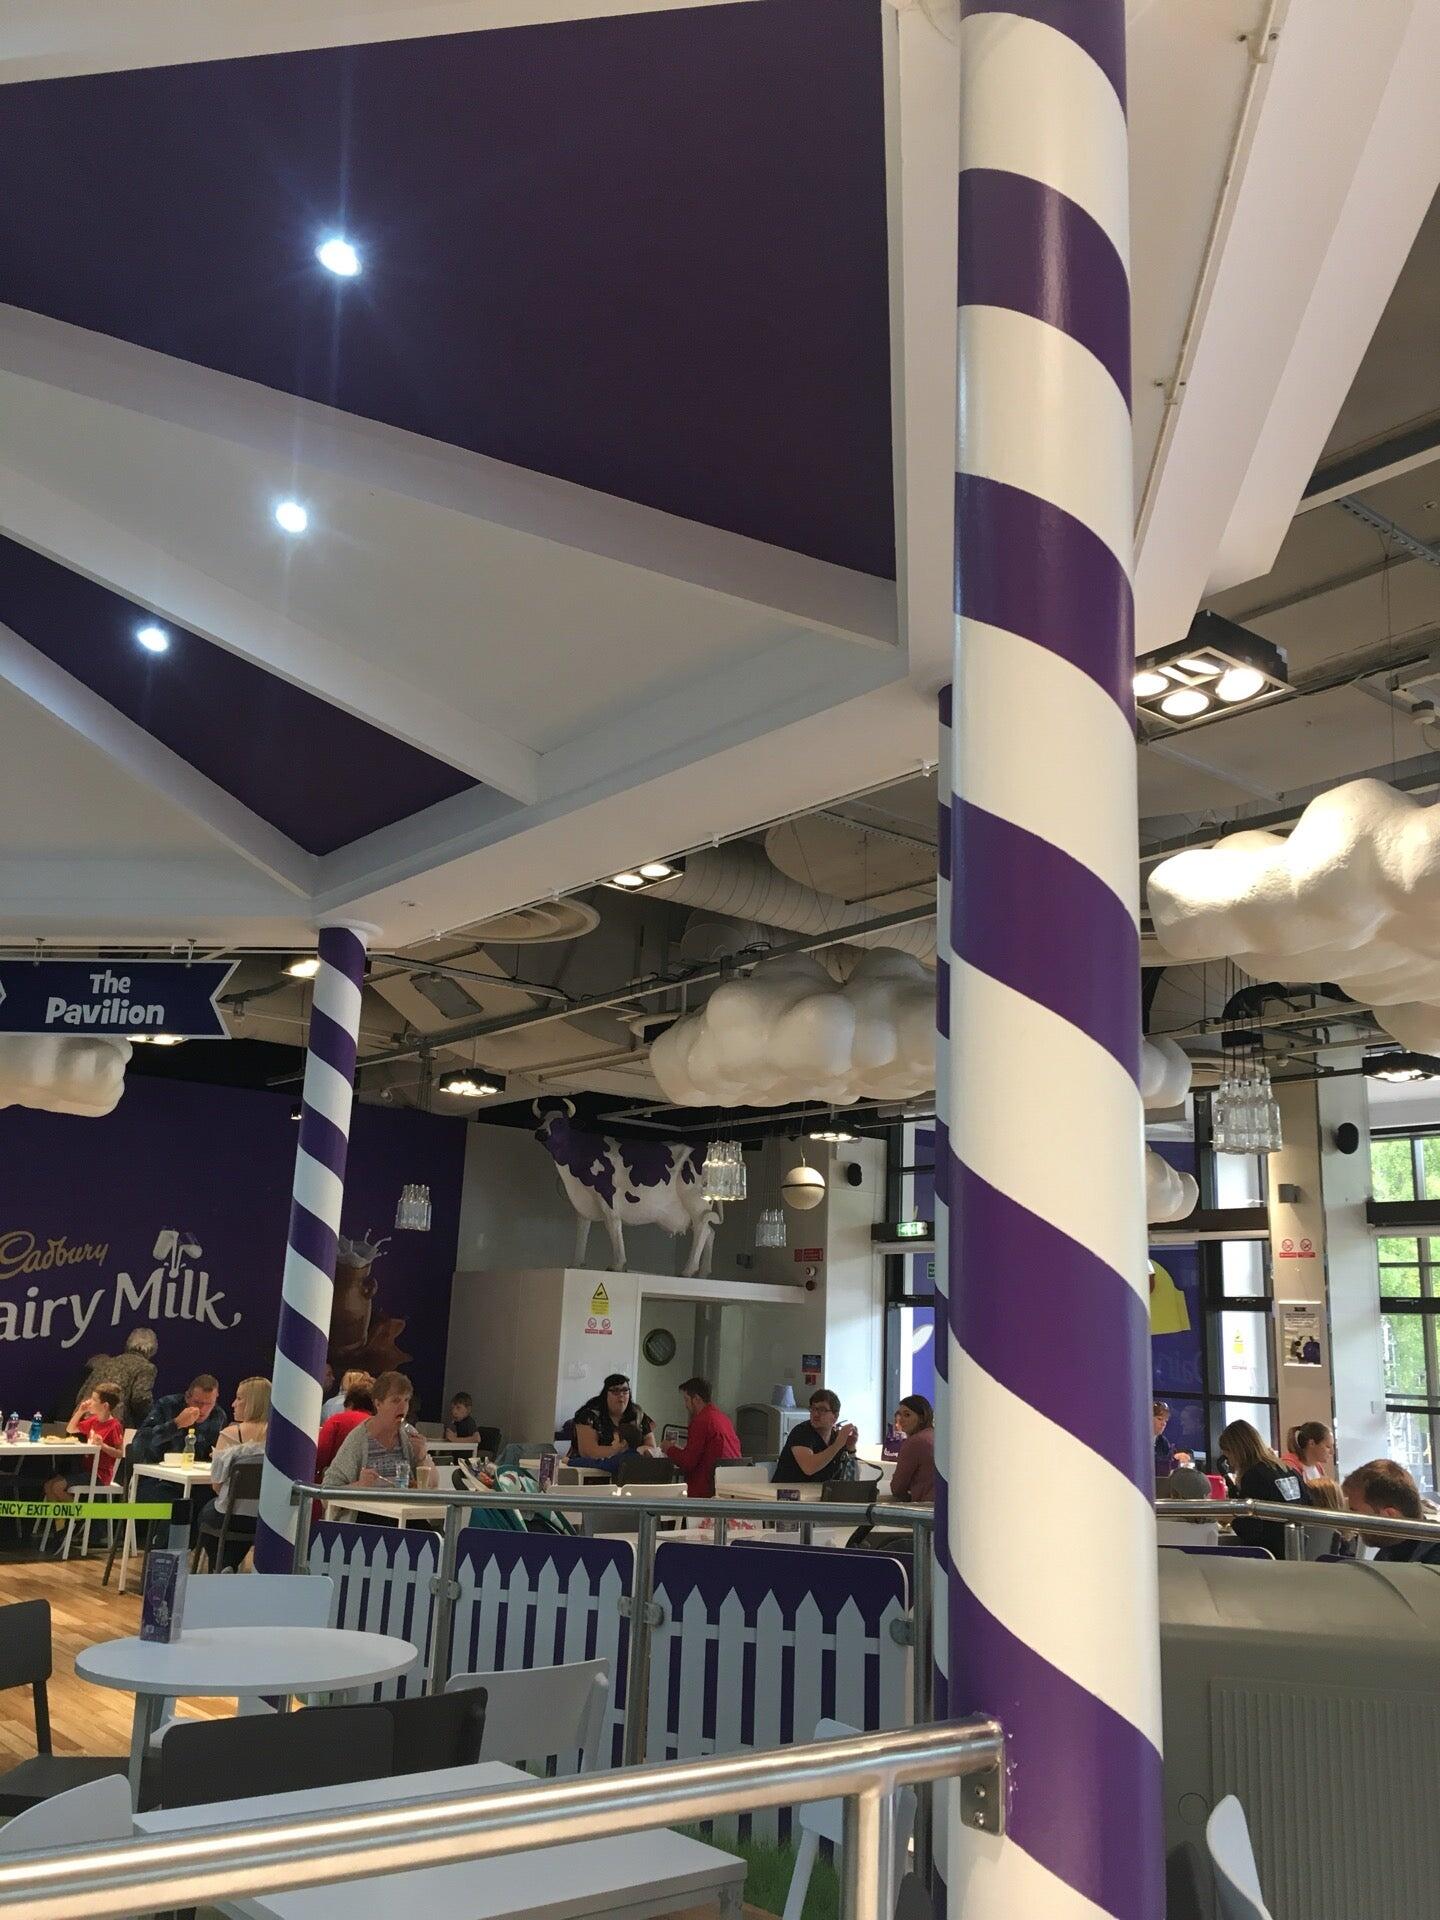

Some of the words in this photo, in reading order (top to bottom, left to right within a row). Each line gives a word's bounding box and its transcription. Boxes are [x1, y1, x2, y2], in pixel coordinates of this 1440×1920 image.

[90, 969, 131, 994] The
[45, 997, 165, 1025] Pavilion
[0, 1230, 109, 1280] Cadbury
[110, 1266, 229, 1330] Milk
[26, 1504, 50, 1516] EXIT
[53, 1504, 82, 1517] ONLY
